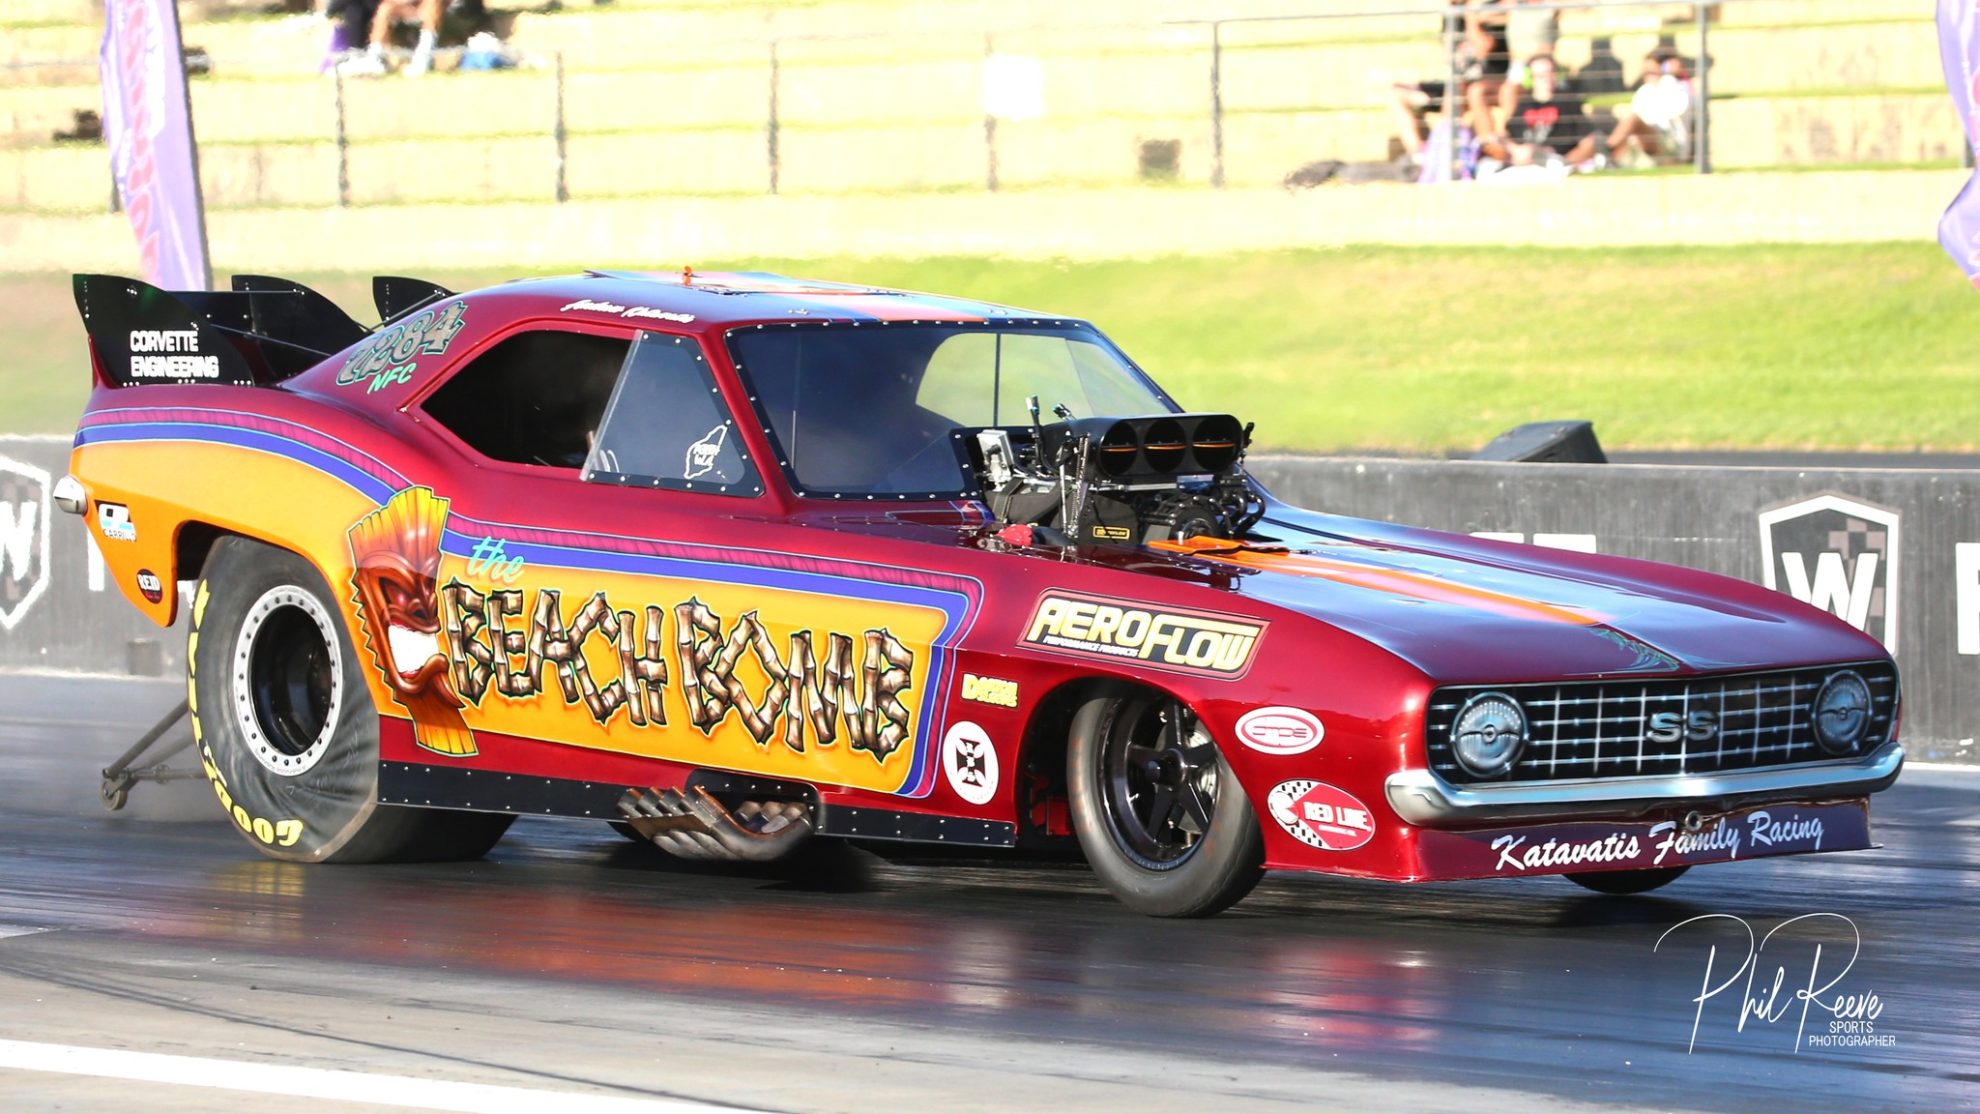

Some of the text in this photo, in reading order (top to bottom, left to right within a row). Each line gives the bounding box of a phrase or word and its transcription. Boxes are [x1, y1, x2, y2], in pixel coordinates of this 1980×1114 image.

[130, 330, 199, 352] CORVETTE
[130, 355, 219, 378] ENGINEERING
[367, 362, 416, 394] NFC
[466, 536, 525, 583] the
[1026, 597, 1260, 671] AEROFLOW
[441, 577, 914, 764] BEACH BOMB
[1648, 710, 1716, 743] SS
[1303, 801, 1334, 823] RED
[1491, 810, 1824, 871] Katavatis Family Racing
